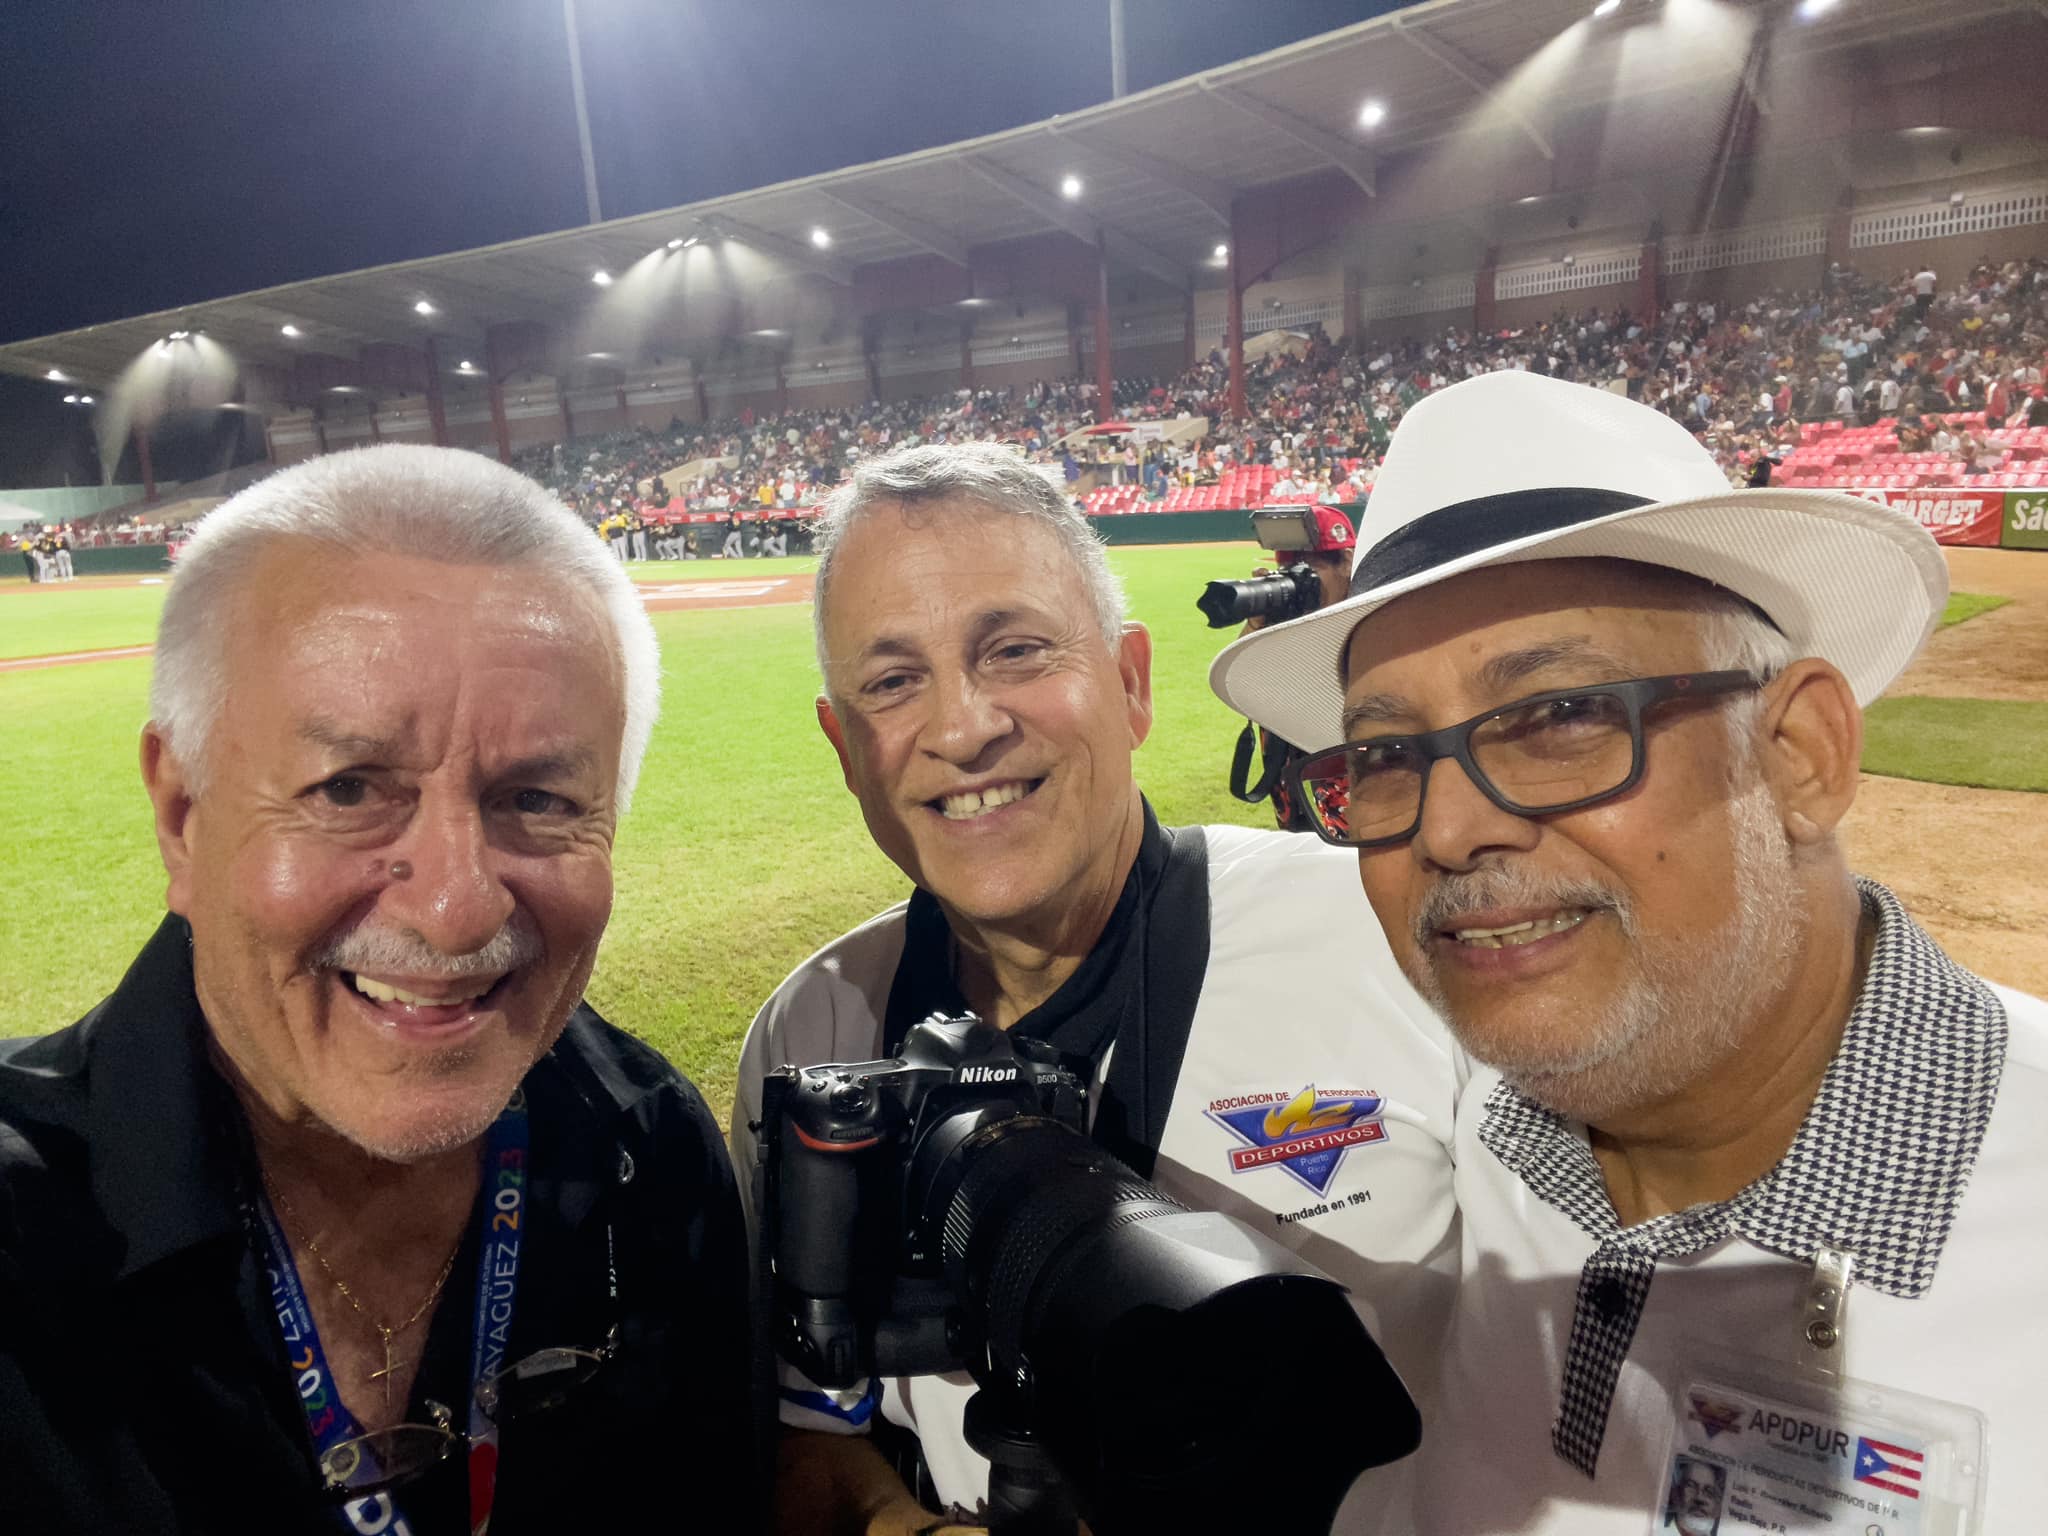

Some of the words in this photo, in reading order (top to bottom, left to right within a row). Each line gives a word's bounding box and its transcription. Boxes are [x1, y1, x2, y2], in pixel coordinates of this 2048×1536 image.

[960, 1067, 1017, 1083] Nikon
[1209, 1092, 1273, 1112] ASOCIACION
[1276, 1091, 1290, 1102] DE
[1241, 1127, 1374, 1164] DEPORTIVOS
[1300, 1153, 1329, 1166] Puerto
[1308, 1165, 1326, 1175] Rico
[493, 1147, 524, 1232] 2023
[1276, 1203, 1329, 1224] Fundada
[1331, 1200, 1345, 1211] en
[1347, 1190, 1372, 1207] 1991
[483, 1241, 519, 1380] AYAGÜEZ
[1748, 1409, 1849, 1458] APDPUR
